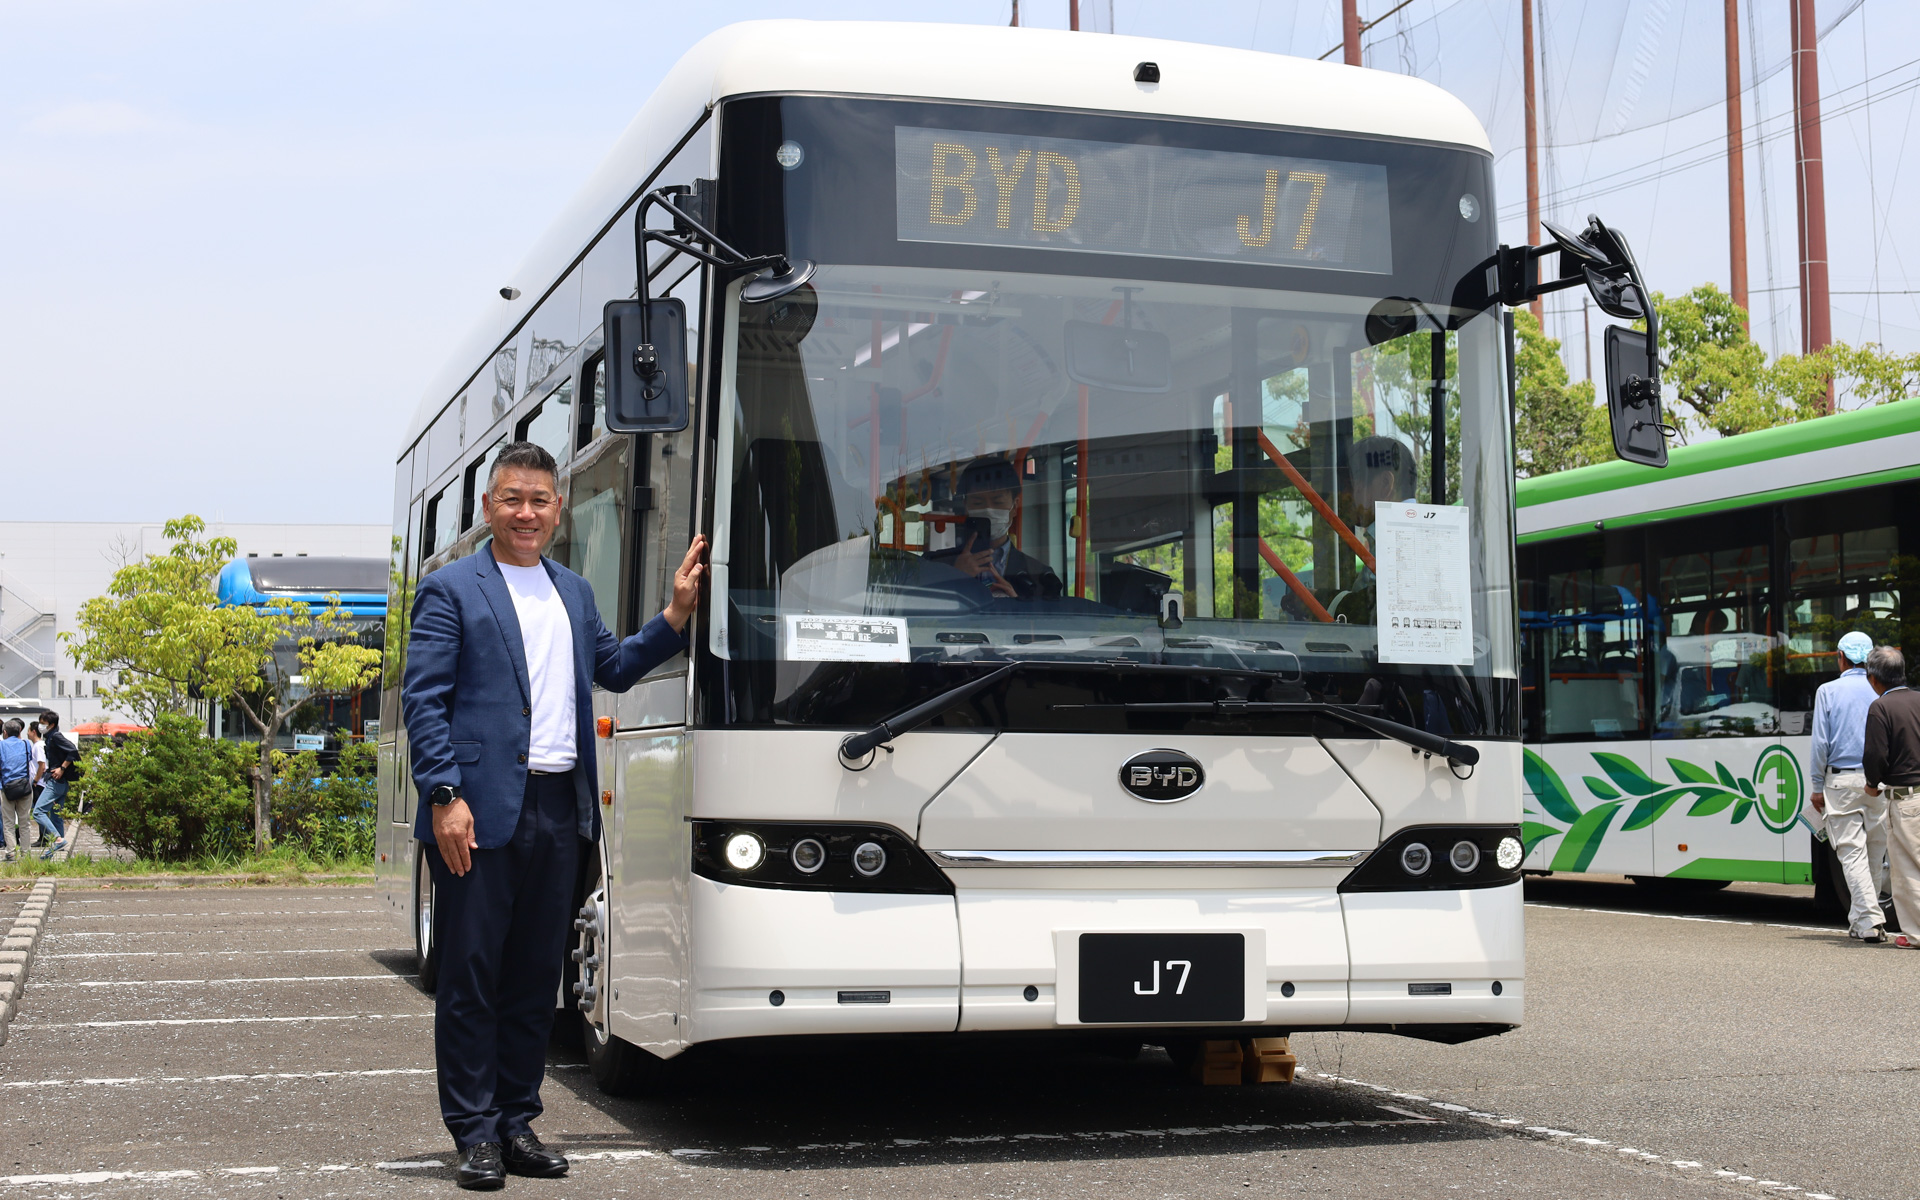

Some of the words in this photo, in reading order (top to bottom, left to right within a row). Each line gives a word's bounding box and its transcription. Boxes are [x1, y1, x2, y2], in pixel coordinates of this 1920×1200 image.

[929, 141, 1082, 234] BYD
[1235, 168, 1328, 252] J7
[800, 622, 895, 635] 試乗・実演・展示
[1130, 766, 1198, 788] BYD
[1133, 960, 1192, 996] J7
